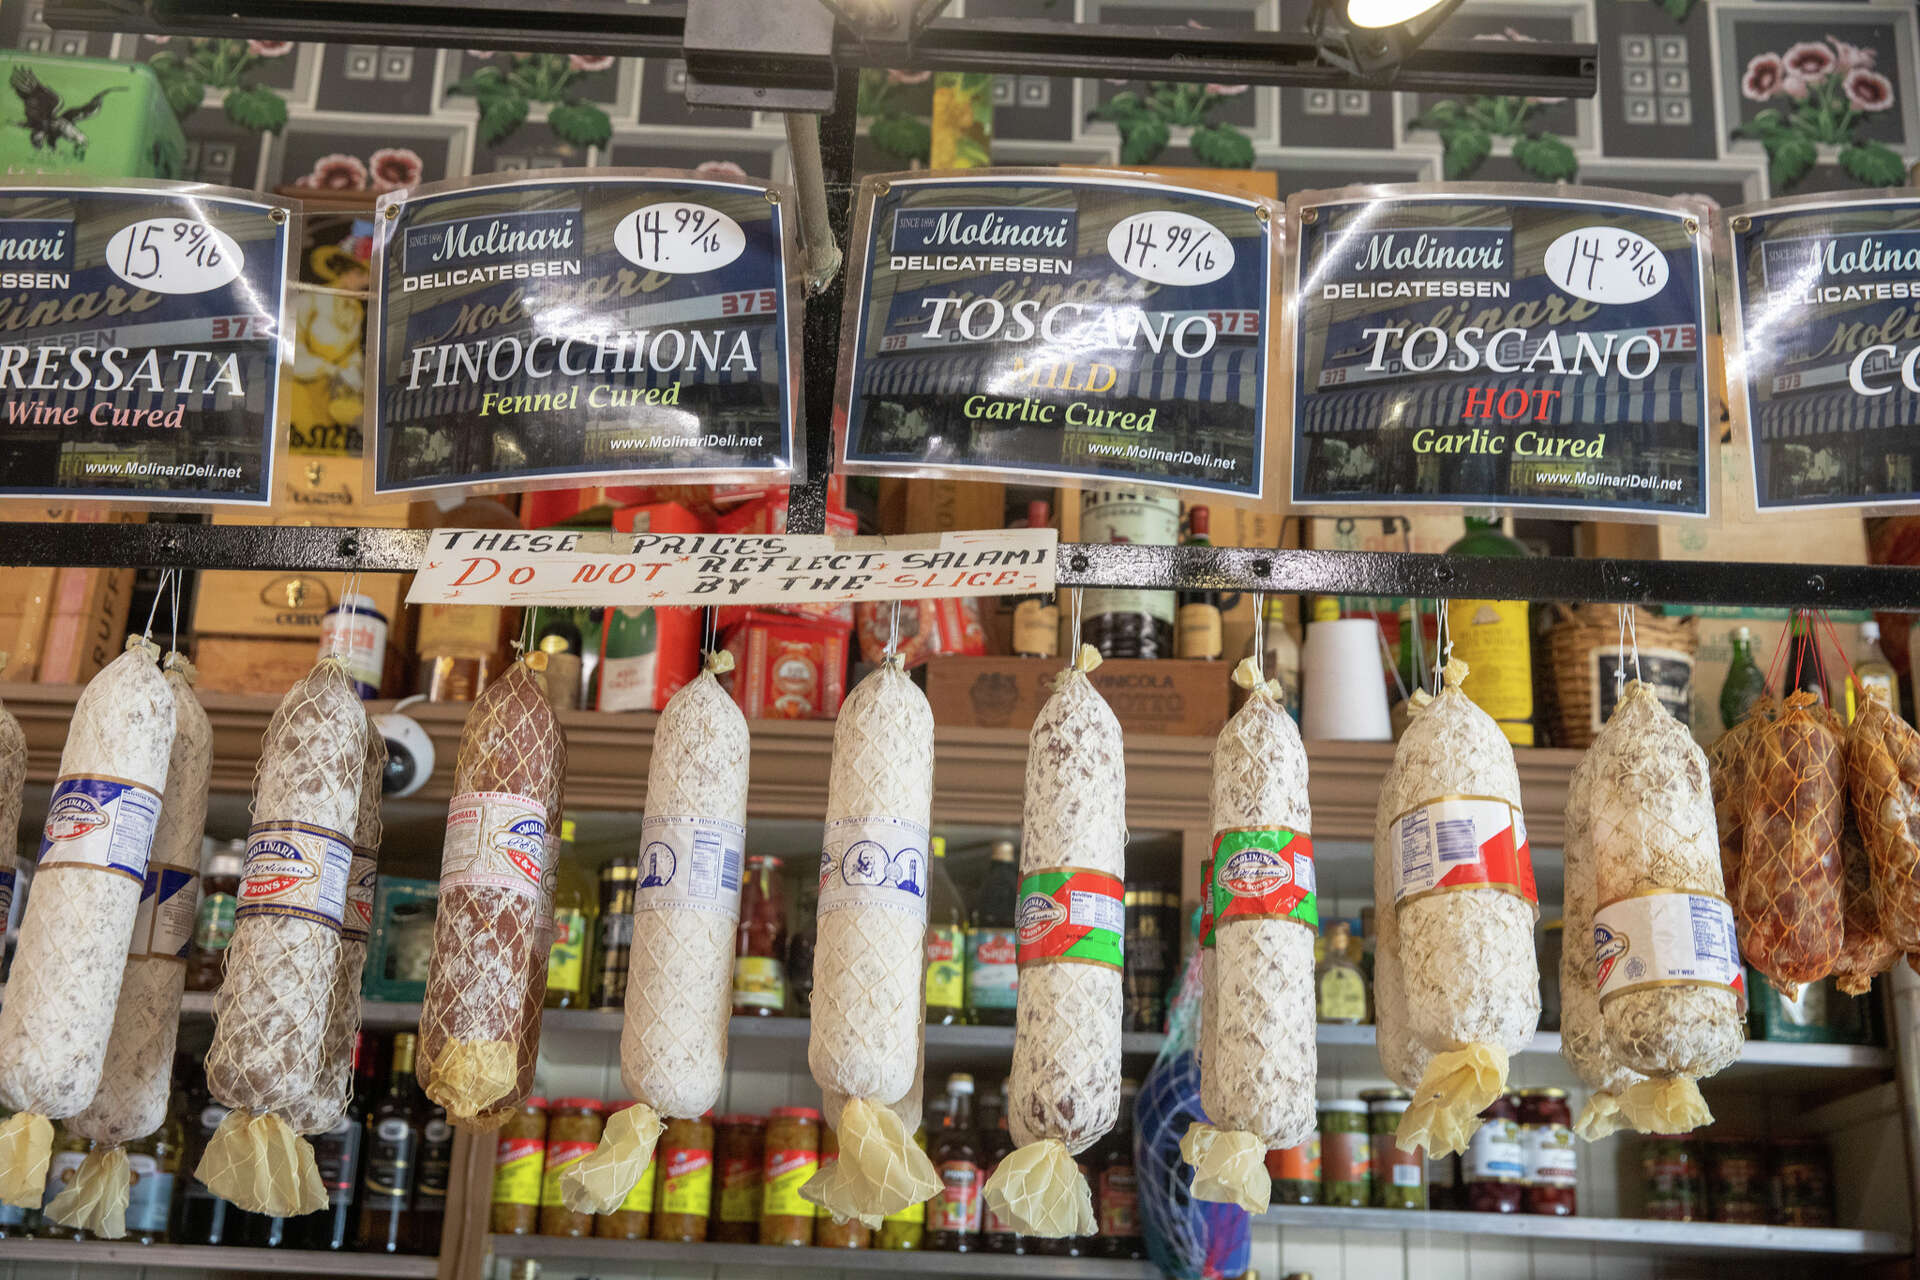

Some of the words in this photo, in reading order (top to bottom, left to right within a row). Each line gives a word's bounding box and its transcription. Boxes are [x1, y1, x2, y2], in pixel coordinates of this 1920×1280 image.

[432, 217, 574, 262] Molinari
[923, 211, 1068, 248] Molinari
[890, 256, 1073, 275] DELICATESSEN
[1355, 234, 1504, 272] Molinari
[0, 273, 70, 289] SSEN
[403, 259, 581, 293] DELICATESSEN
[722, 288, 777, 315] 373
[1323, 281, 1510, 300] DELICATESSEN
[920, 297, 1217, 359] TOSCANO
[884, 336, 907, 350] 373
[1362, 327, 1660, 380] TOSCANO
[0, 346, 245, 396] RESSATA
[406, 329, 758, 391] FINOCCHIONA
[1011, 356, 1118, 393] MILD
[1323, 368, 1347, 384] 373
[479, 386, 577, 416] Fennel
[589, 381, 681, 409] Cured
[1461, 388, 1561, 420] HOT
[8, 401, 79, 425] Wine
[90, 402, 186, 428] Cured
[963, 394, 1055, 424] Garlic
[1065, 401, 1157, 433] Cured
[610, 434, 763, 451] www.MolinariDeli.net
[1087, 441, 1236, 471] www.MolinariDeli.net
[1412, 427, 1504, 455] Garlic
[1515, 432, 1605, 460] Cured
[85, 462, 242, 479] www.MolinariDeli.net
[1535, 470, 1682, 492] www.MolinariDeli.net
[440, 530, 583, 552] THESE
[632, 534, 787, 555] PRICES
[572, 562, 672, 584] NOT
[698, 552, 887, 573] REFLECT
[902, 548, 1047, 570] SALAMI
[687, 576, 752, 595] BY
[778, 575, 872, 592] THE
[250, 879, 281, 894] SONS
